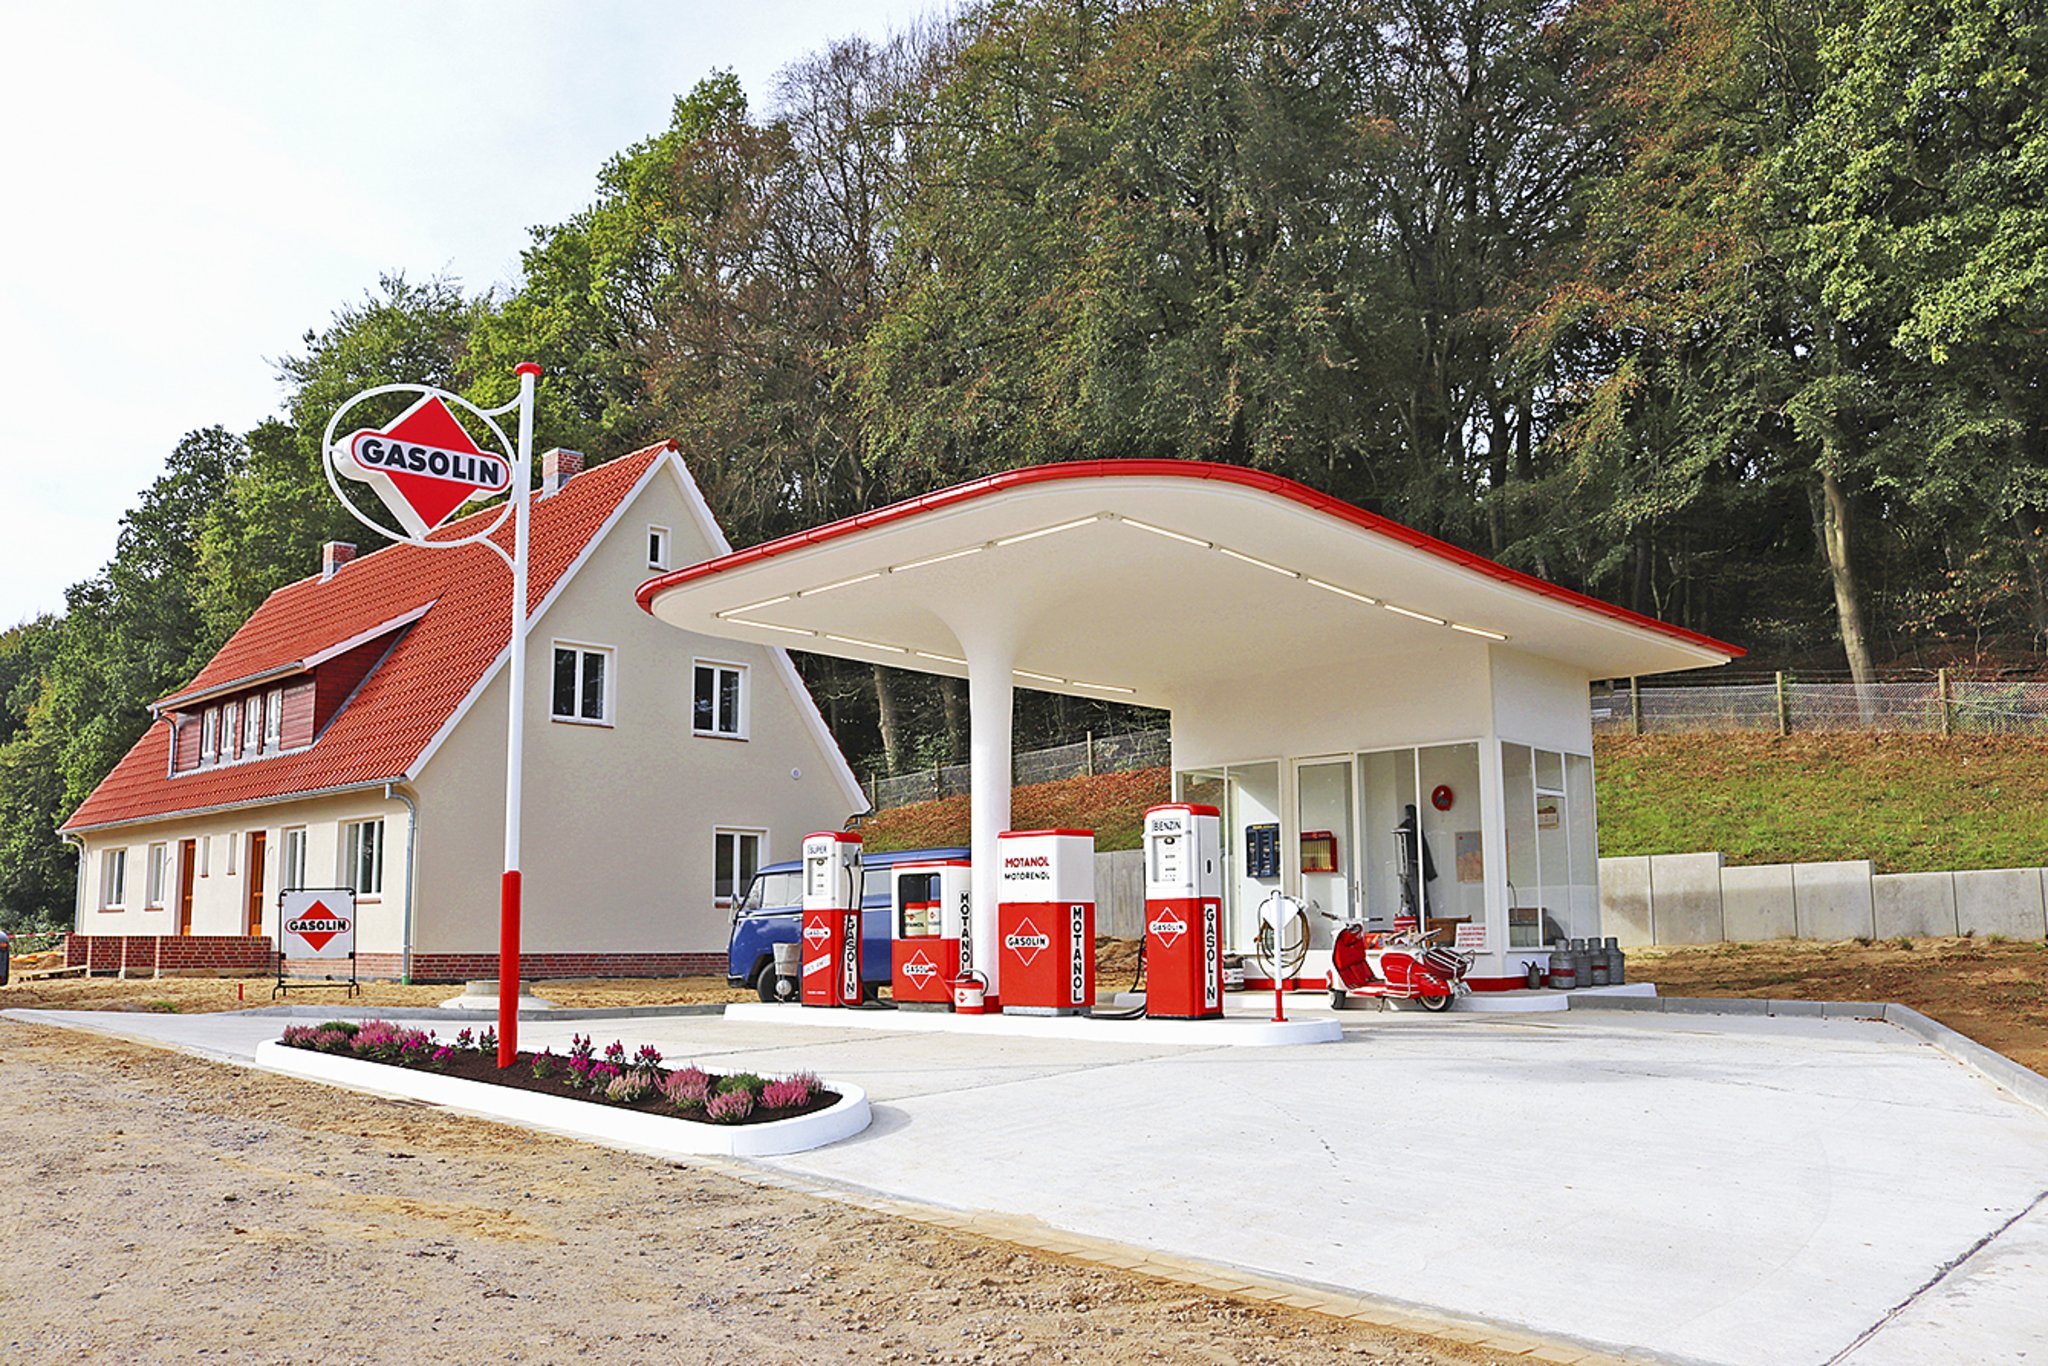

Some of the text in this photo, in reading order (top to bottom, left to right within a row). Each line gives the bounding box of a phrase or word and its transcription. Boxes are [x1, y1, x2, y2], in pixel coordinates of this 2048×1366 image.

[362, 439, 499, 485] GASOLIN
[1154, 820, 1181, 831] BENZIN
[809, 845, 827, 854] SUPER
[1005, 857, 1049, 868] MOTANOL
[289, 920, 346, 930] GASOLIN
[1008, 937, 1046, 946] GASOLIN
[1073, 907, 1082, 1001] MOTANOL
[1206, 908, 1215, 1000] GASOLIN
[905, 965, 935, 974] GASOL
